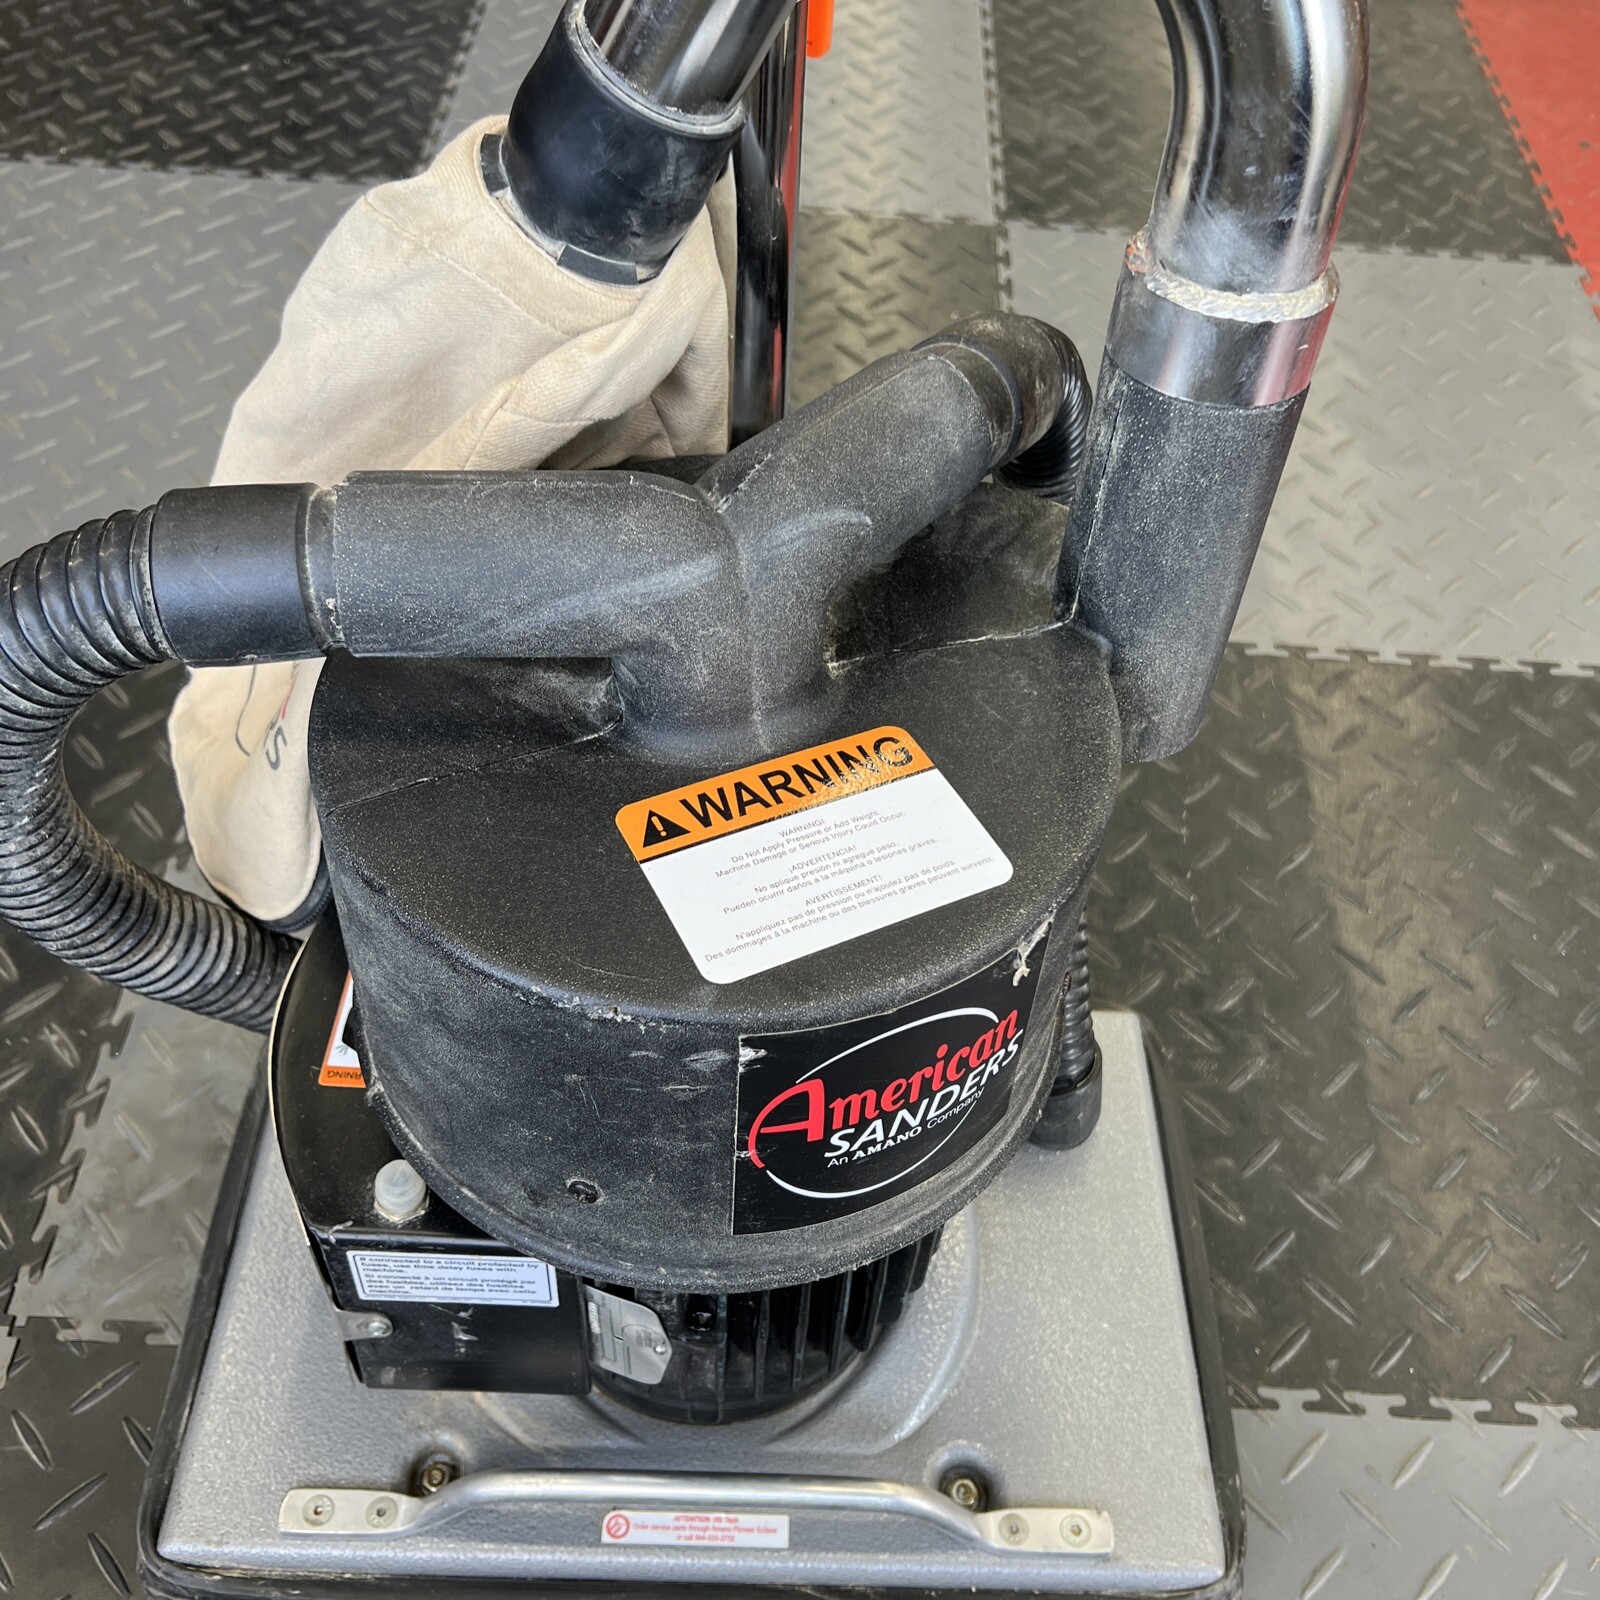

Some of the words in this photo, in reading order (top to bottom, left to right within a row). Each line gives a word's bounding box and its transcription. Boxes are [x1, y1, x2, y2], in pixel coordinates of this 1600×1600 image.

[679, 736, 913, 829] WARNING
[715, 862, 751, 878] Machine
[752, 851, 787, 867] Damage
[798, 836, 831, 850] Serious
[831, 828, 853, 840] Injury
[855, 820, 879, 831] Could
[731, 856, 744, 864] Do
[744, 849, 762, 858] Not
[762, 842, 785, 854] Apply
[786, 829, 822, 846] Pressure
[834, 820, 850, 830] Add
[779, 818, 825, 838] WARNING!
[723, 899, 757, 914] Pueden
[758, 889, 785, 903] ocurrir
[787, 879, 813, 893] daños
[820, 872, 830, 881] la
[831, 861, 866, 877] máquina
[874, 847, 908, 863] lesiones
[735, 919, 786, 941] N'appliquez
[788, 913, 803, 923] pas
[804, 908, 816, 916] de
[817, 896, 854, 913] pression
[866, 877, 903, 895] n'ajoutez
[904, 872, 920, 883] pas
[921, 867, 931, 875] de
[754, 885, 768, 894] No
[770, 874, 799, 889] aplique
[801, 863, 831, 880] presión
[832, 859, 841, 868] ni
[843, 848, 875, 865] agregue
[805, 873, 883, 906] AVERTISSEMENT!
[704, 951, 724, 962] Des
[725, 933, 773, 955] dommages
[774, 930, 781, 938] à
[782, 927, 791, 936] la
[792, 915, 827, 932] machine
[841, 903, 858, 914] des
[859, 890, 898, 908] blessures
[898, 879, 927, 894] graves
[927, 868, 960, 884] peuvent
[327, 1070, 362, 1080] RNING
[748, 1009, 1018, 1168] American
[824, 1028, 1024, 1158] SANDERS
[827, 1156, 848, 1168] An
[851, 1127, 923, 1161] AMANO
[926, 1087, 985, 1130] Company
